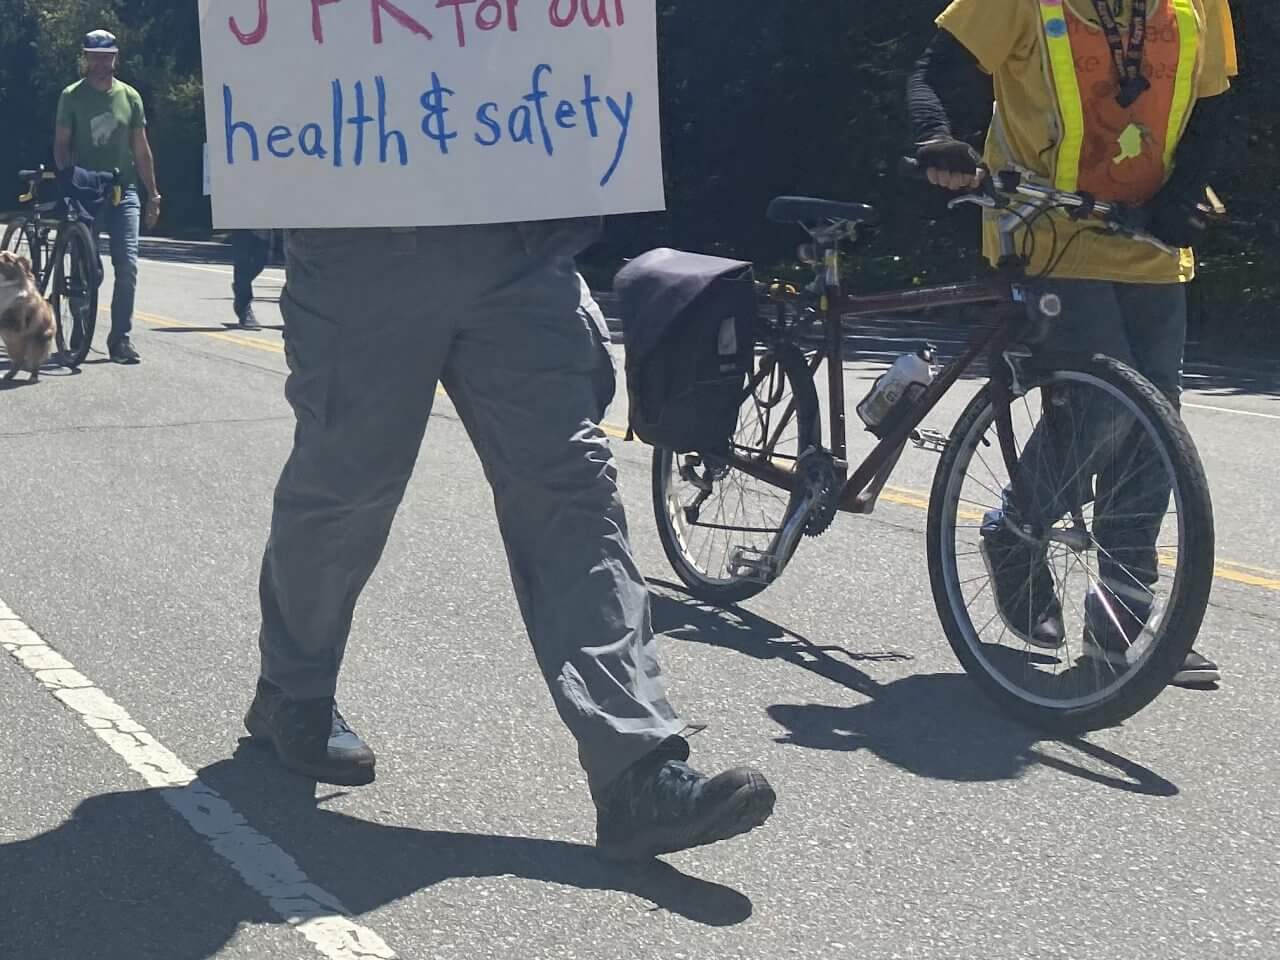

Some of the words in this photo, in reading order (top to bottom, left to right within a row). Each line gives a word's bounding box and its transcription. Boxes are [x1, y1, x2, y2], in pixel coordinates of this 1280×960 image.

[222, 75, 408, 167] health
[419, 71, 458, 155] &
[474, 63, 634, 187] safety
